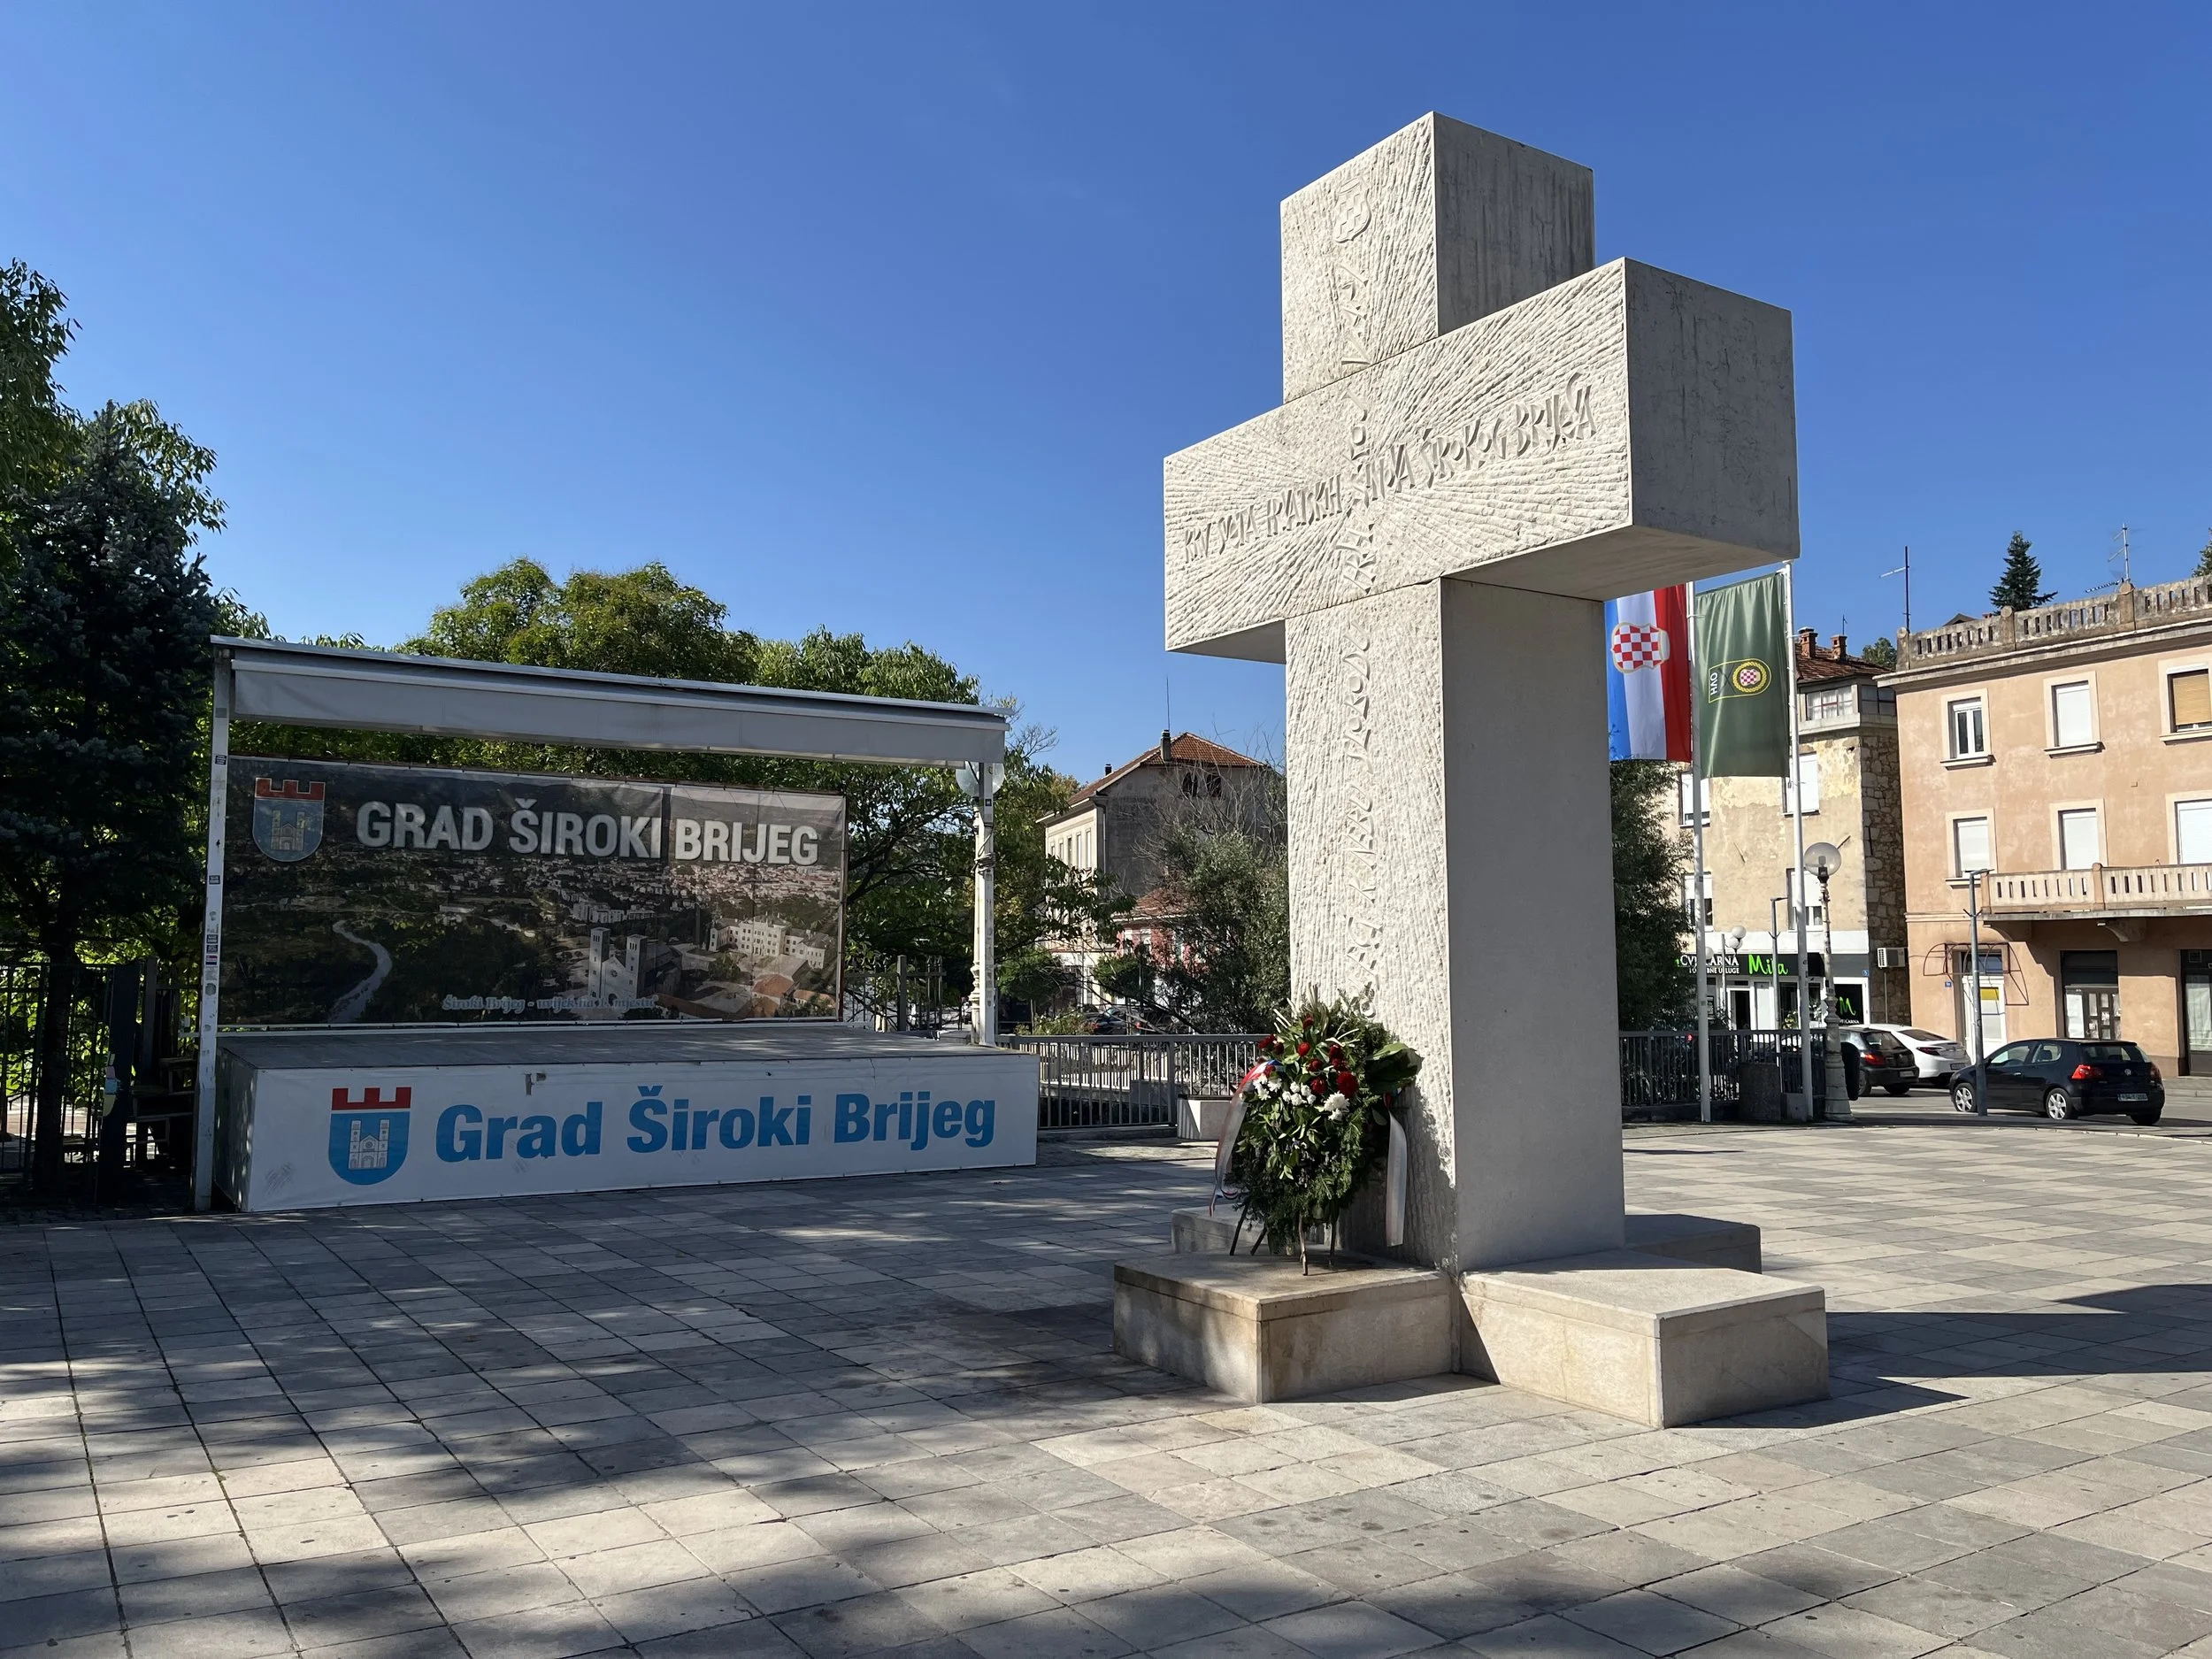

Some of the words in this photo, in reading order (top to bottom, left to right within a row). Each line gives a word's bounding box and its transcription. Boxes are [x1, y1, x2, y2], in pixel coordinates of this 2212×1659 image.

[357, 801, 493, 851] GRAD
[509, 798, 663, 859] ŠIROKI
[676, 818, 818, 864] BRIJEG
[436, 1101, 602, 1163] Grad
[627, 1085, 811, 1153] Široki
[834, 1090, 996, 1149] Brijeg
